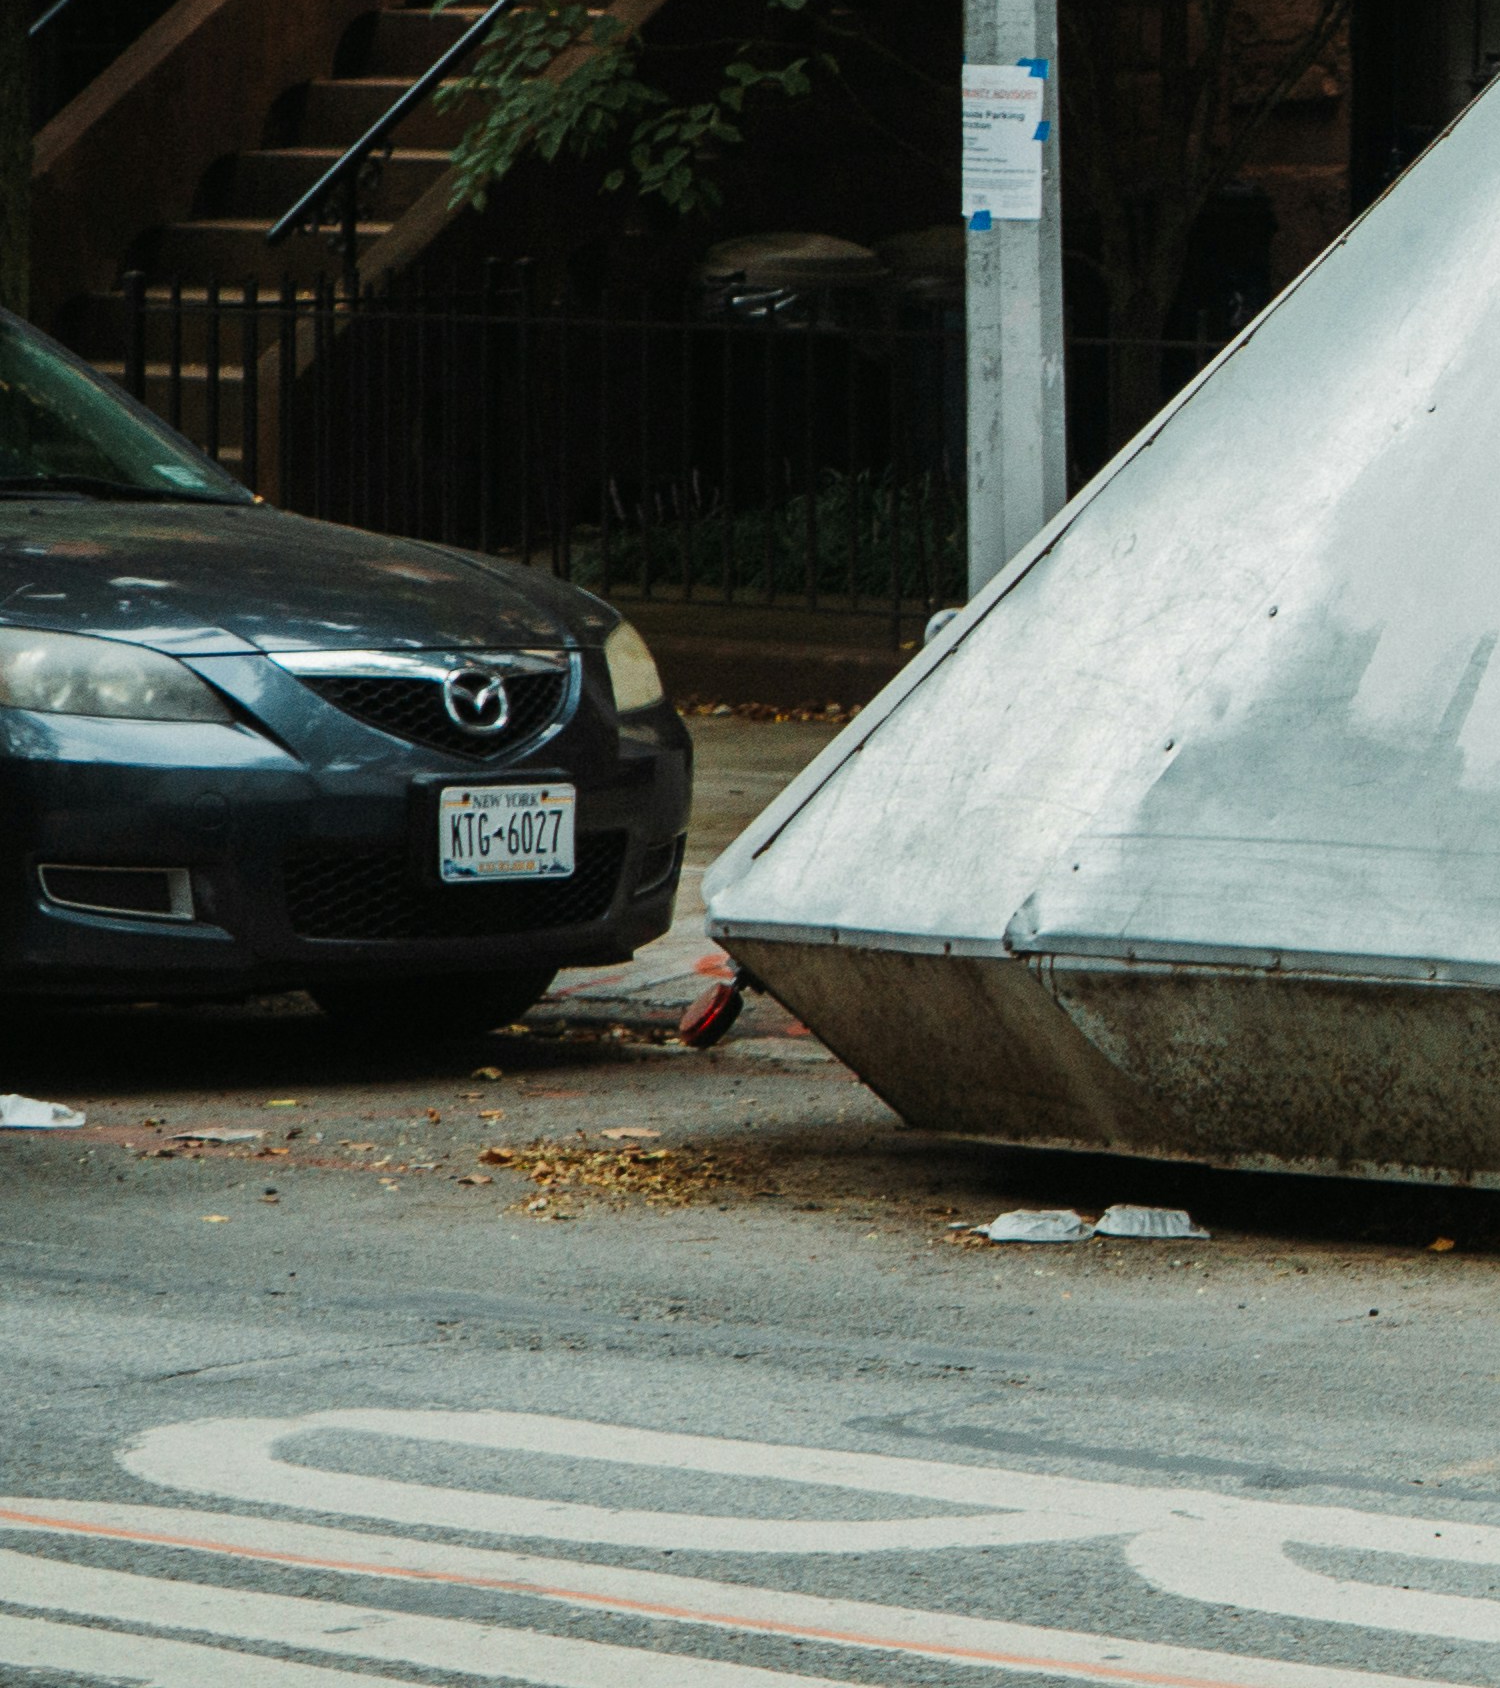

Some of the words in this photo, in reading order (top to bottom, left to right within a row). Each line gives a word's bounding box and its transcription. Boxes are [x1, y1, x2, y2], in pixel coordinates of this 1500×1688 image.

[985, 110, 1025, 121] Parking
[472, 793, 502, 809] NEW
[504, 792, 539, 808] YORK
